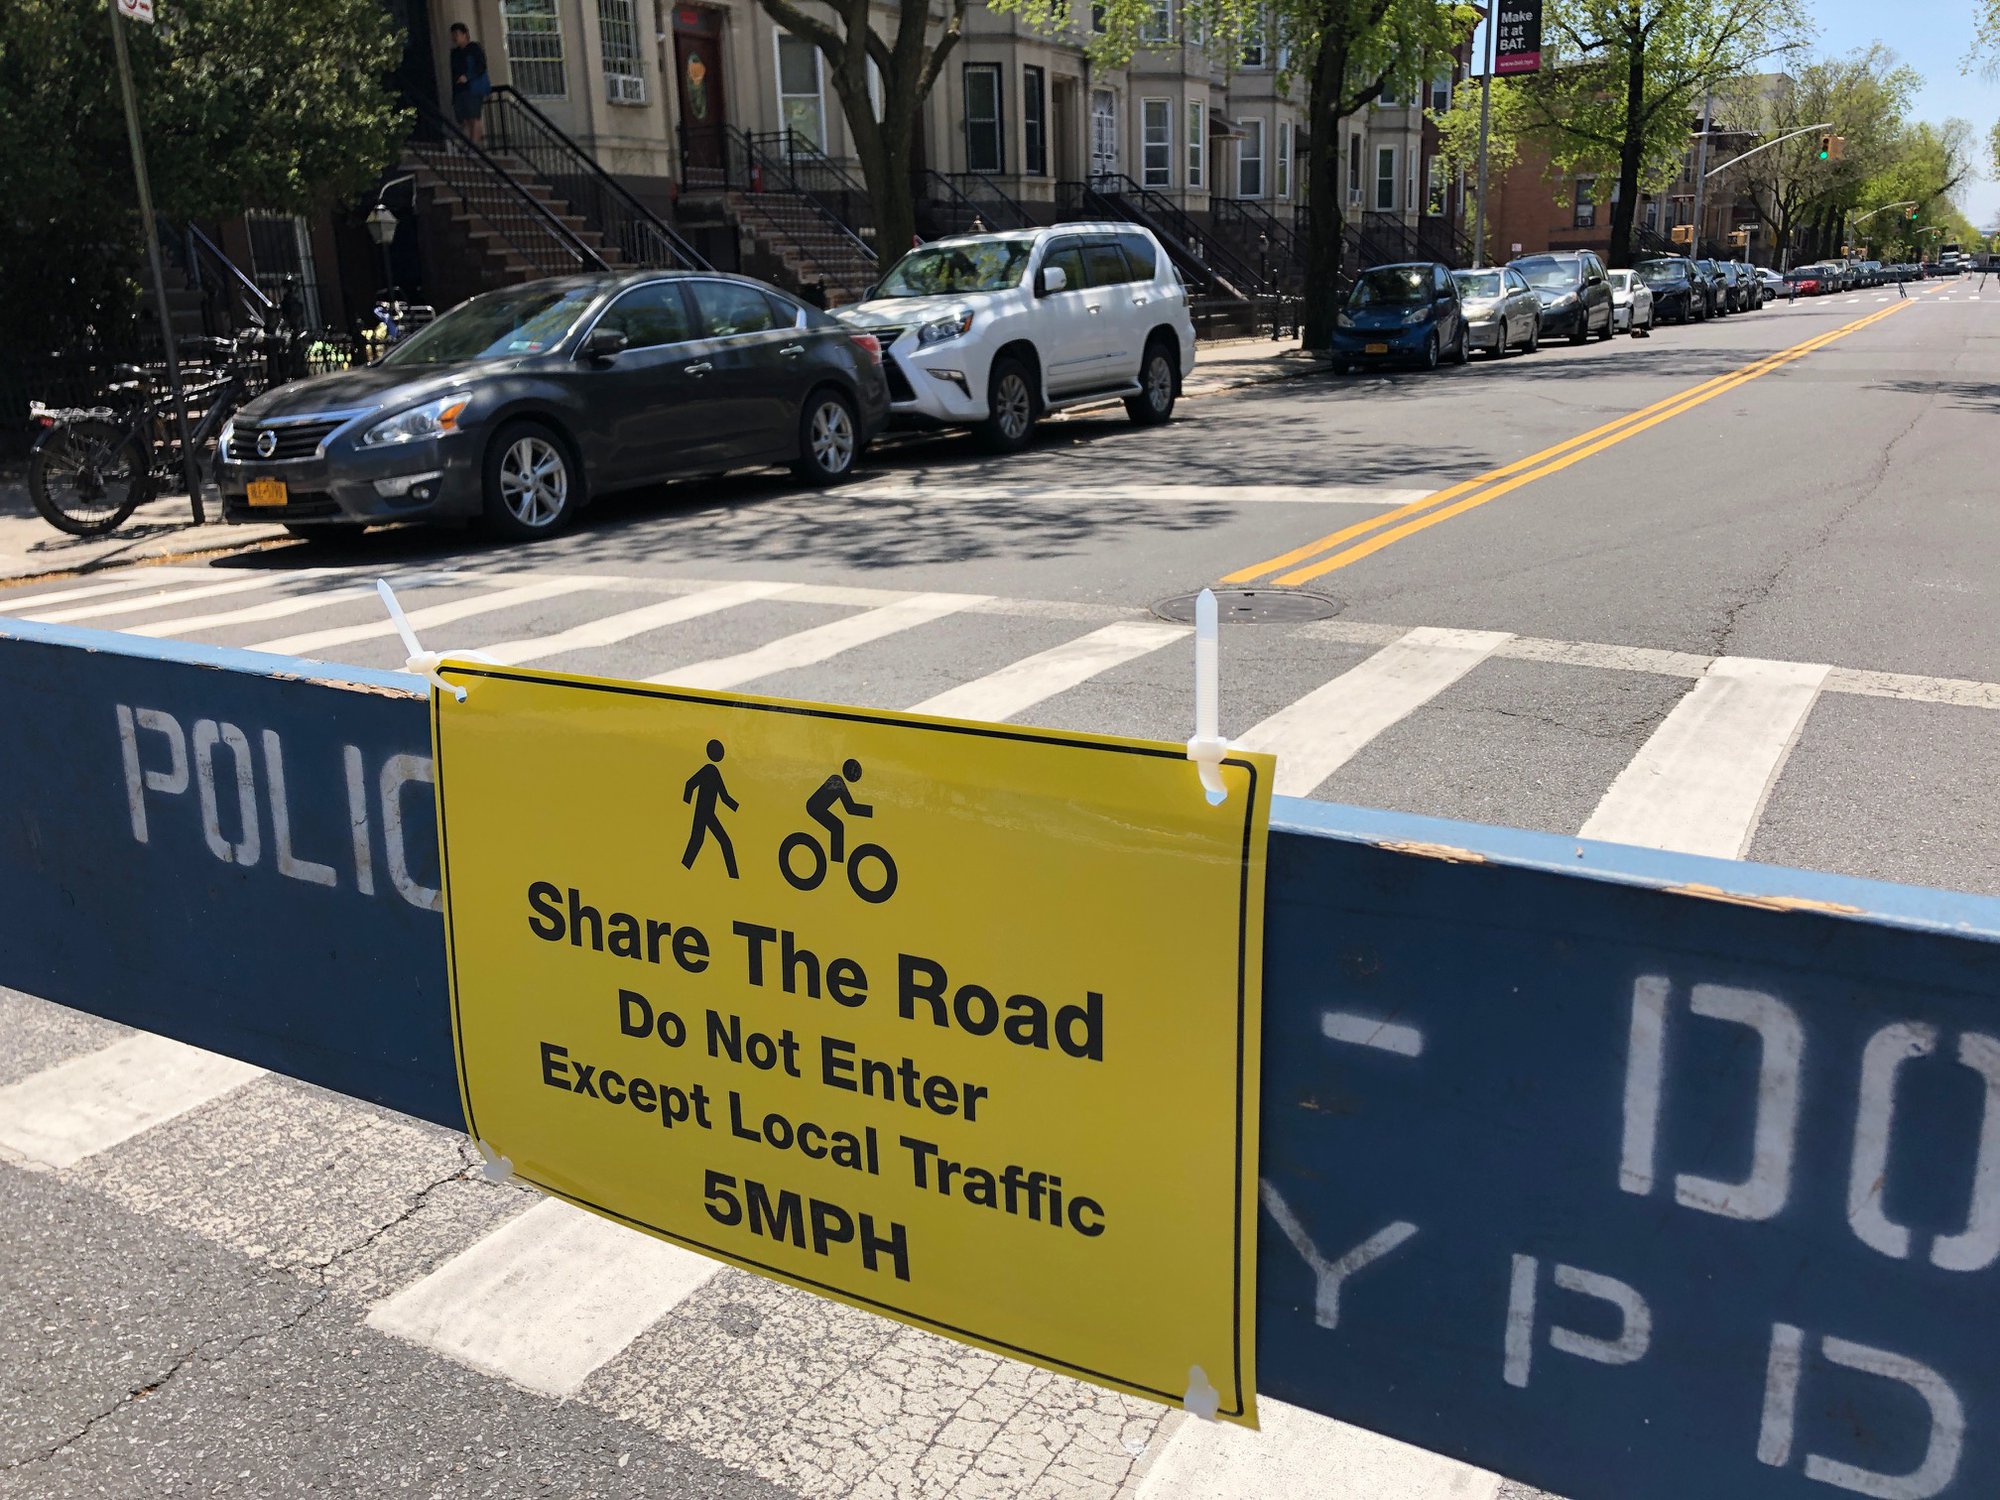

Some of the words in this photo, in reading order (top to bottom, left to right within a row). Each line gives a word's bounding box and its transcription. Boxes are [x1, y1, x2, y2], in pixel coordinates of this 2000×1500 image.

[1500, 26, 1508, 37] it
[1511, 25, 1523, 36] at
[1500, 38, 1526, 50] BAT.
[1501, 11, 1533, 23] Make
[528, 882, 709, 973] Share
[733, 921, 868, 1008] The
[899, 953, 1103, 1062] Road
[618, 989, 686, 1048] Do
[706, 1009, 801, 1078] Not
[821, 1036, 988, 1122] Enter
[540, 1042, 711, 1129] Except
[729, 1091, 880, 1175] Local
[900, 1136, 1106, 1237] Traffic
[1619, 975, 2000, 1271] DO
[704, 1169, 911, 1283] 5MPH
